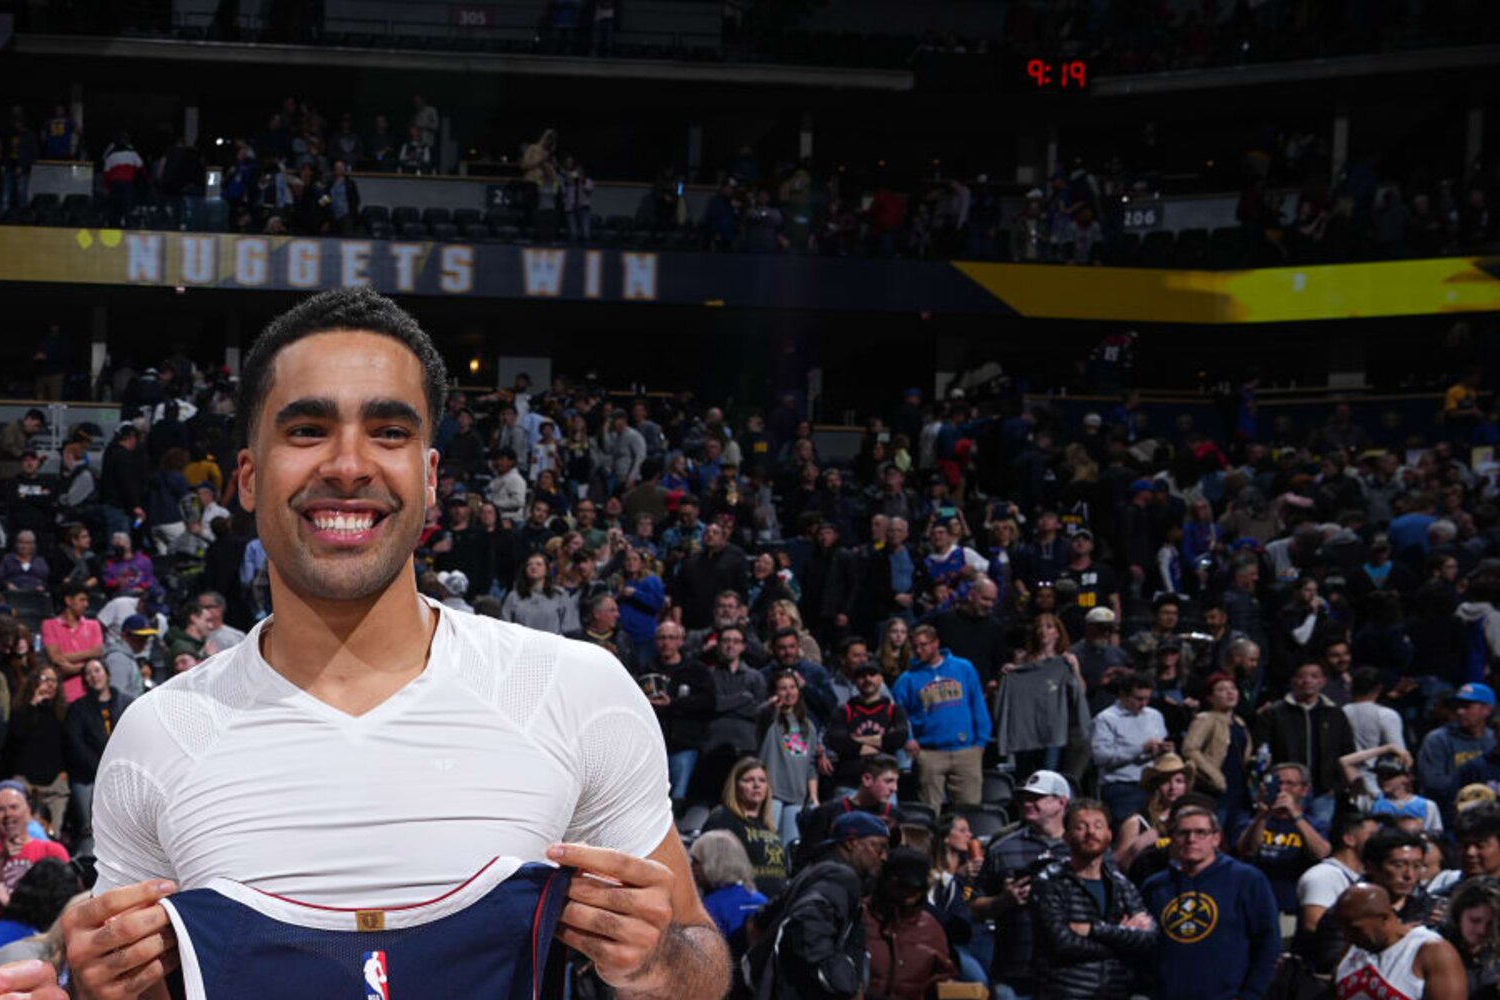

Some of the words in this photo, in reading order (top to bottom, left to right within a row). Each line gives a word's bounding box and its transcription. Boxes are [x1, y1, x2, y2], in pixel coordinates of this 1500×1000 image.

[1026, 58, 1088, 89] 9:19
[125, 232, 475, 293] NUGGETS
[522, 248, 659, 300] WIN
